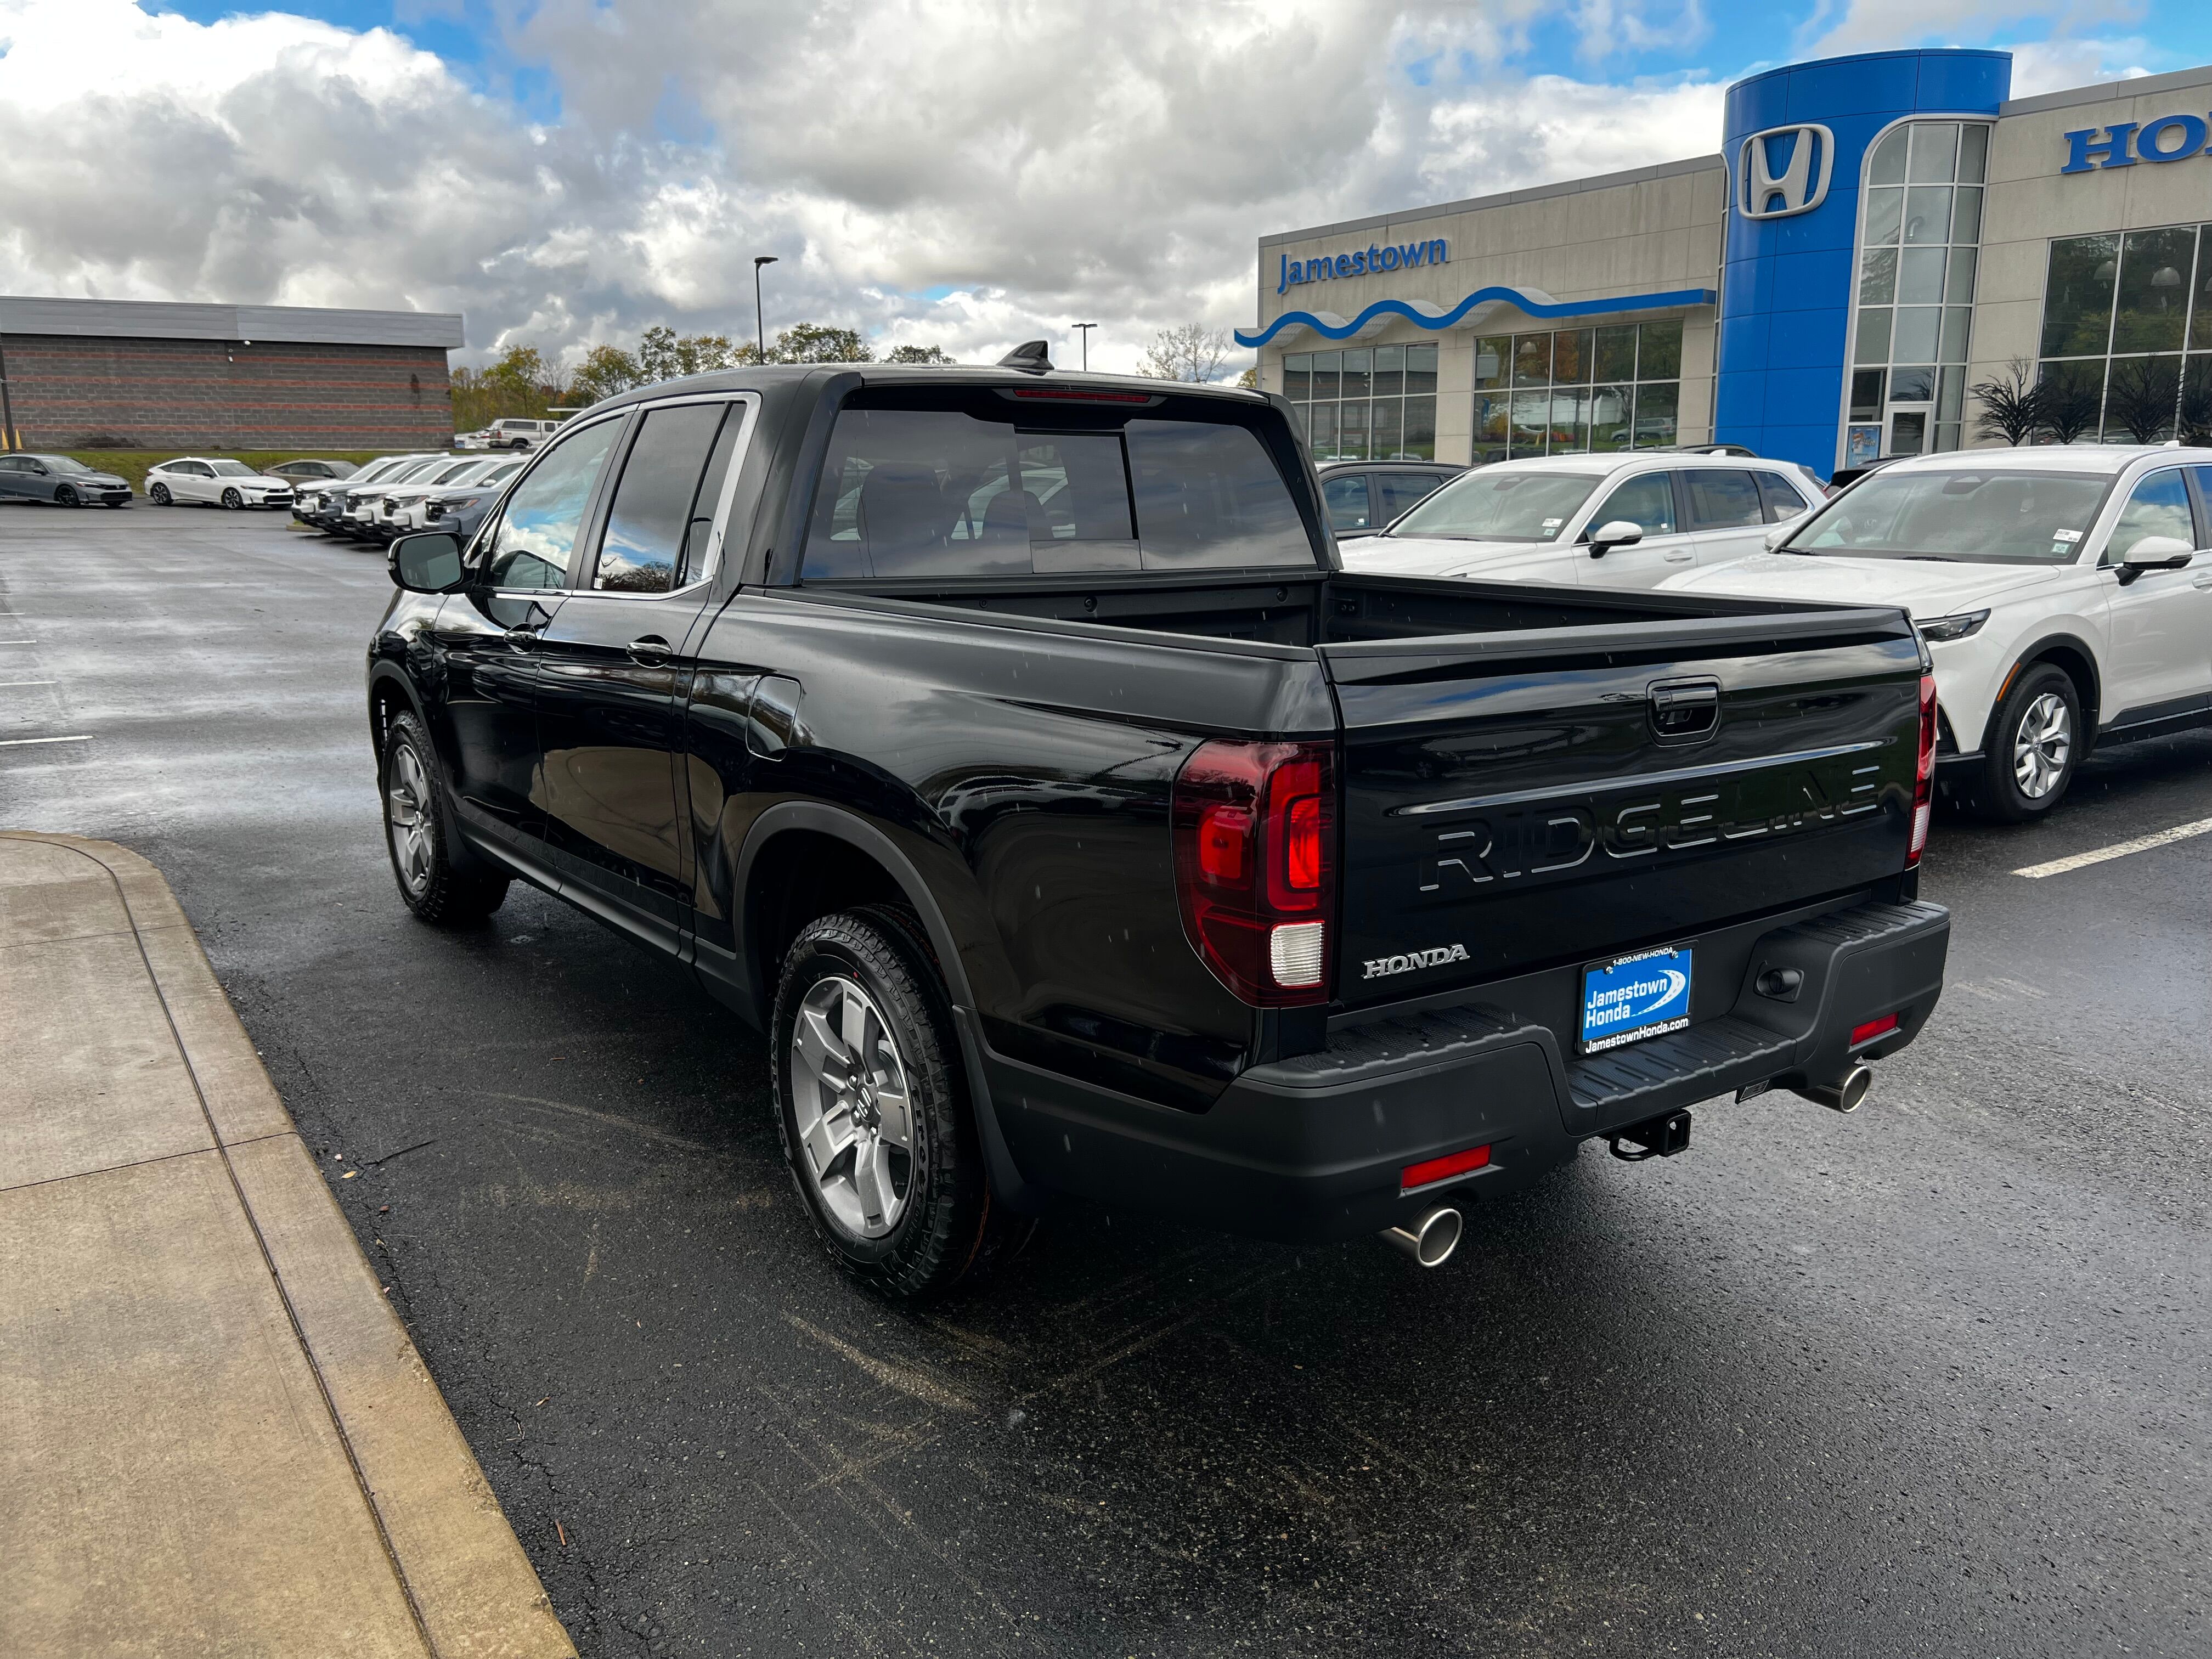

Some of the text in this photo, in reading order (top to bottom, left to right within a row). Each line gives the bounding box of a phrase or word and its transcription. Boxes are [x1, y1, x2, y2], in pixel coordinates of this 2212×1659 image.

[2061, 111, 2212, 174] HO
[1277, 238, 1450, 295] Jamestown
[1419, 765, 1883, 891] RIDGELINE
[1361, 943, 1470, 979] HONDA
[1612, 946, 1673, 966] 1-800-NEW-HONDA
[1587, 978, 1667, 1009] Jamestown
[1585, 1002, 1630, 1028] Honda
[1585, 1018, 1689, 1053] JamestownHonda.com
